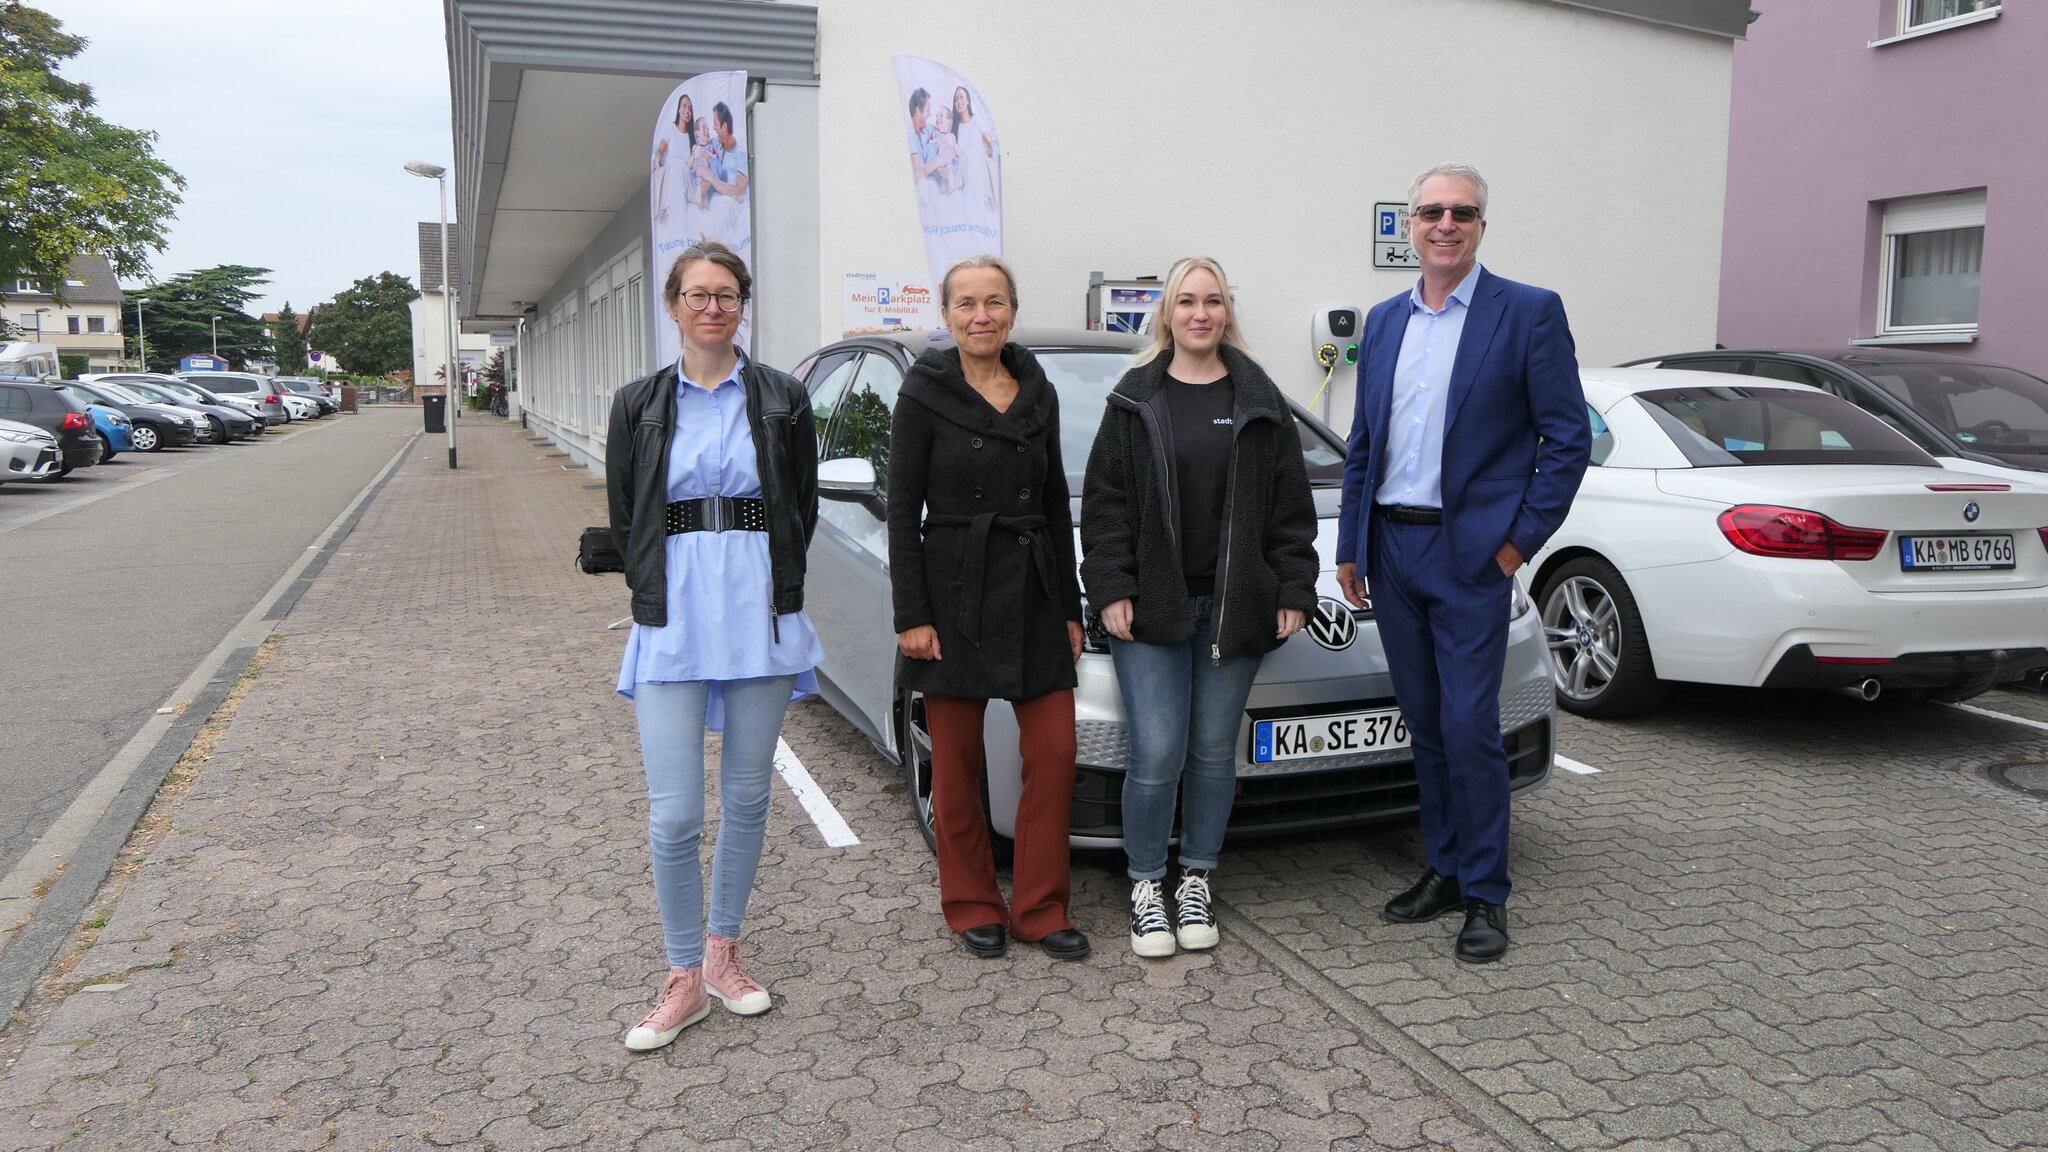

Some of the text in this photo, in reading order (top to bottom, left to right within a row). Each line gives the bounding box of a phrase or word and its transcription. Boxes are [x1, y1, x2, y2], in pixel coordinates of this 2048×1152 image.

[1382, 215, 1393, 232] P
[852, 288, 932, 305] Mein Parkplatz
[877, 306, 919, 314] E-Mobilität
[1914, 540, 1937, 563] KA
[1949, 540, 1970, 562] MB
[1974, 539, 2012, 562] 6766
[1260, 745, 1268, 756] D
[1275, 724, 1308, 756] KA
[1327, 719, 1358, 750] SE
